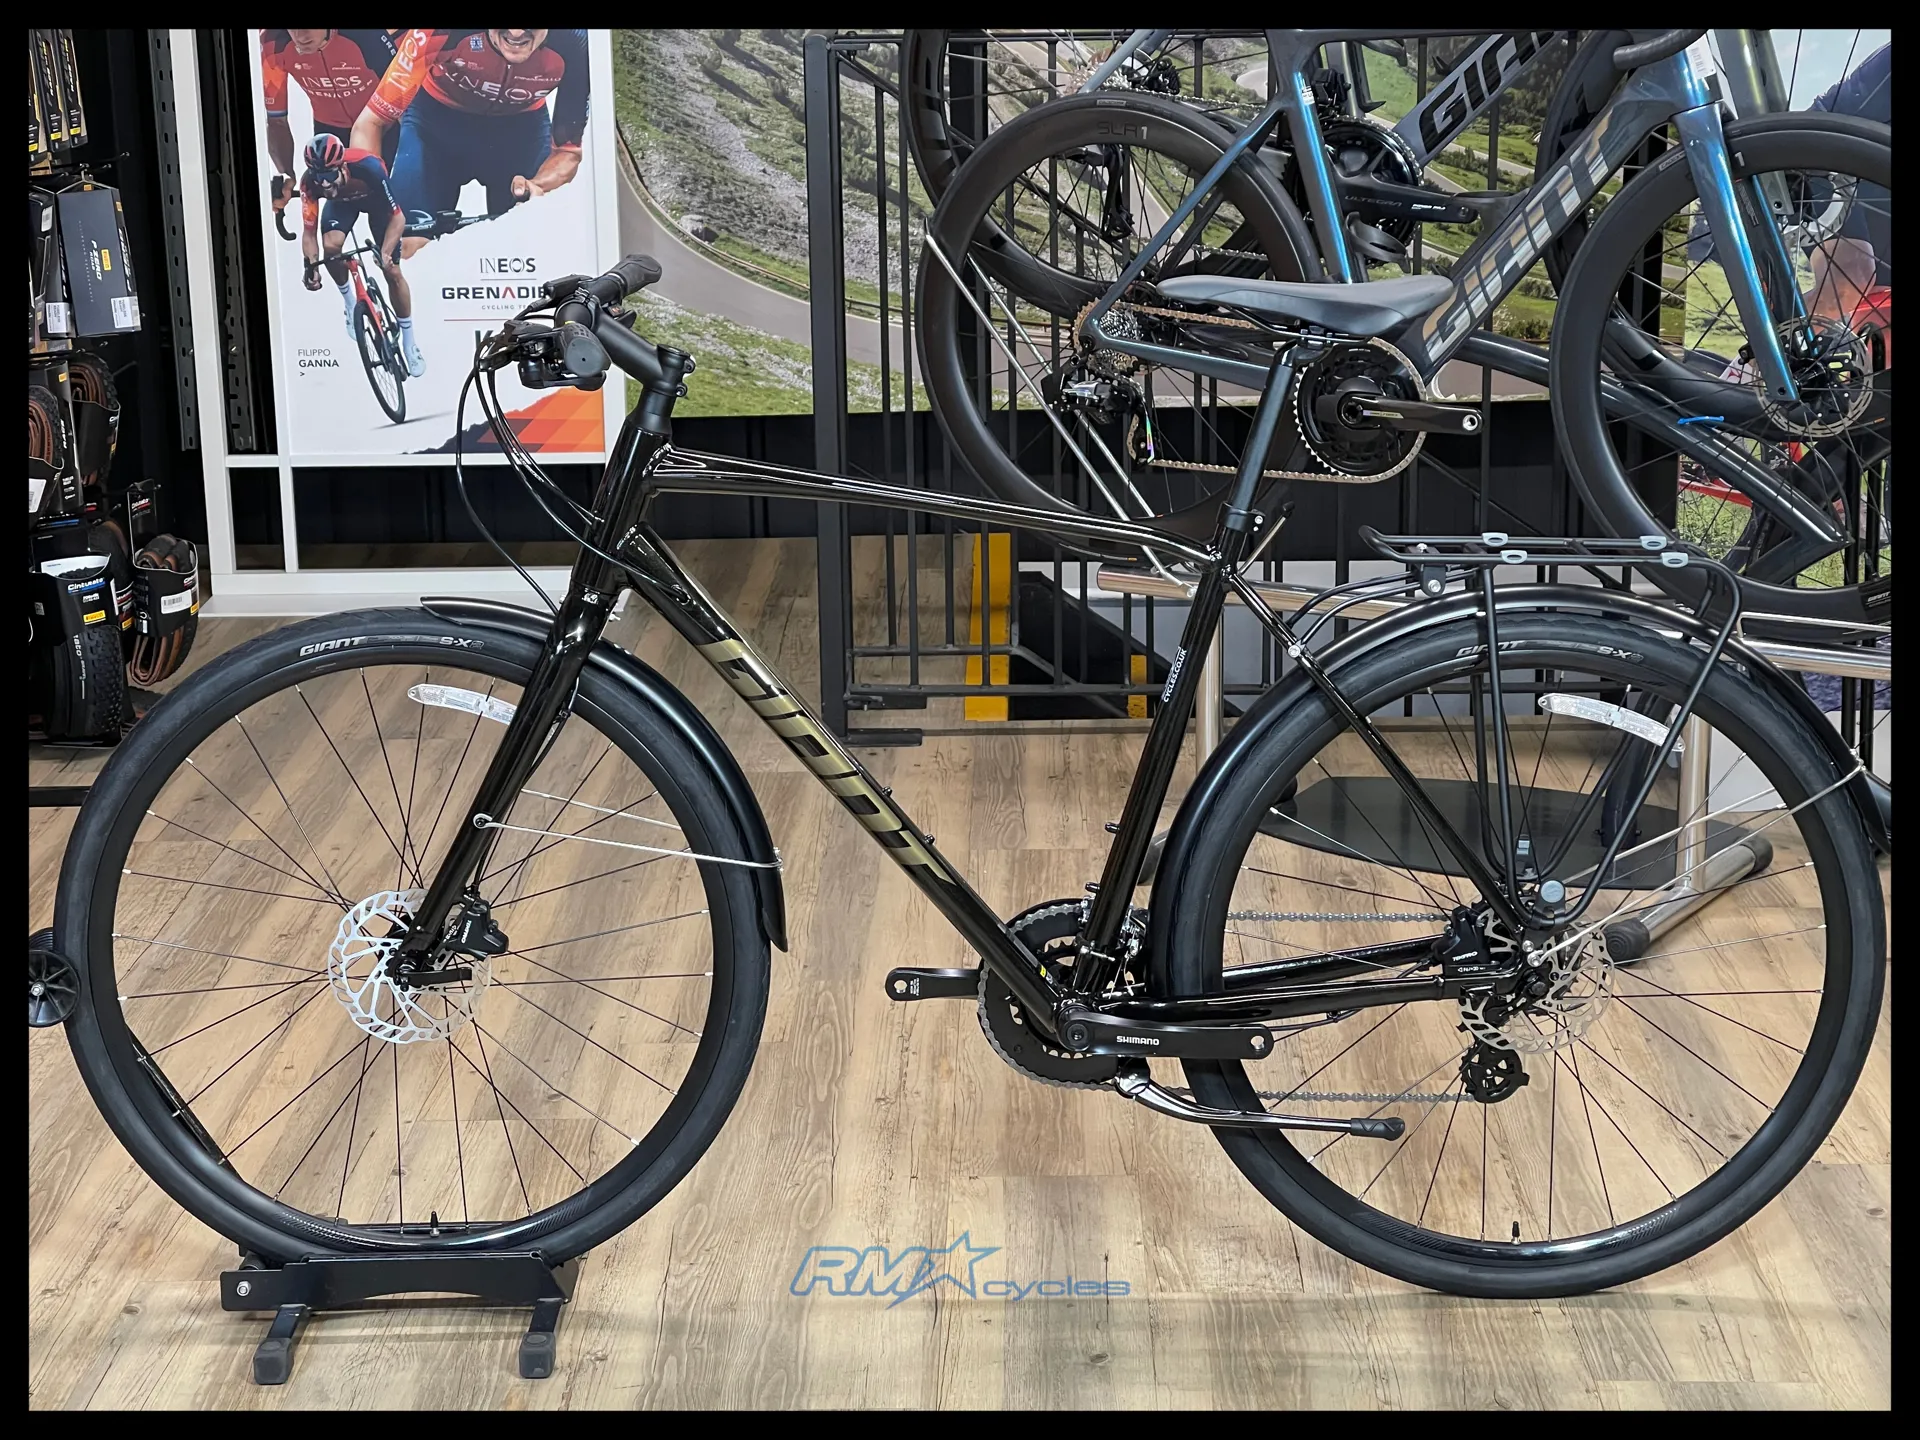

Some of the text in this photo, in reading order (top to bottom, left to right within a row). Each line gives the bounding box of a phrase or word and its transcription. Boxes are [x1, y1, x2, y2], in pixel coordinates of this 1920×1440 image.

[387, 29, 427, 92] INEOS
[301, 75, 362, 88] INEOS
[1097, 121, 1148, 140] SLR 1
[1422, 107, 1614, 363] GIANT
[92, 249, 102, 281] ZERO
[480, 257, 536, 273] INEOS
[297, 348, 331, 357] FILIPPO
[298, 359, 340, 368] GANNA
[299, 635, 367, 658] GIANT
[1163, 648, 1188, 703] CYCLES.CO.UK
[1116, 1035, 1160, 1046] SHIMANO
